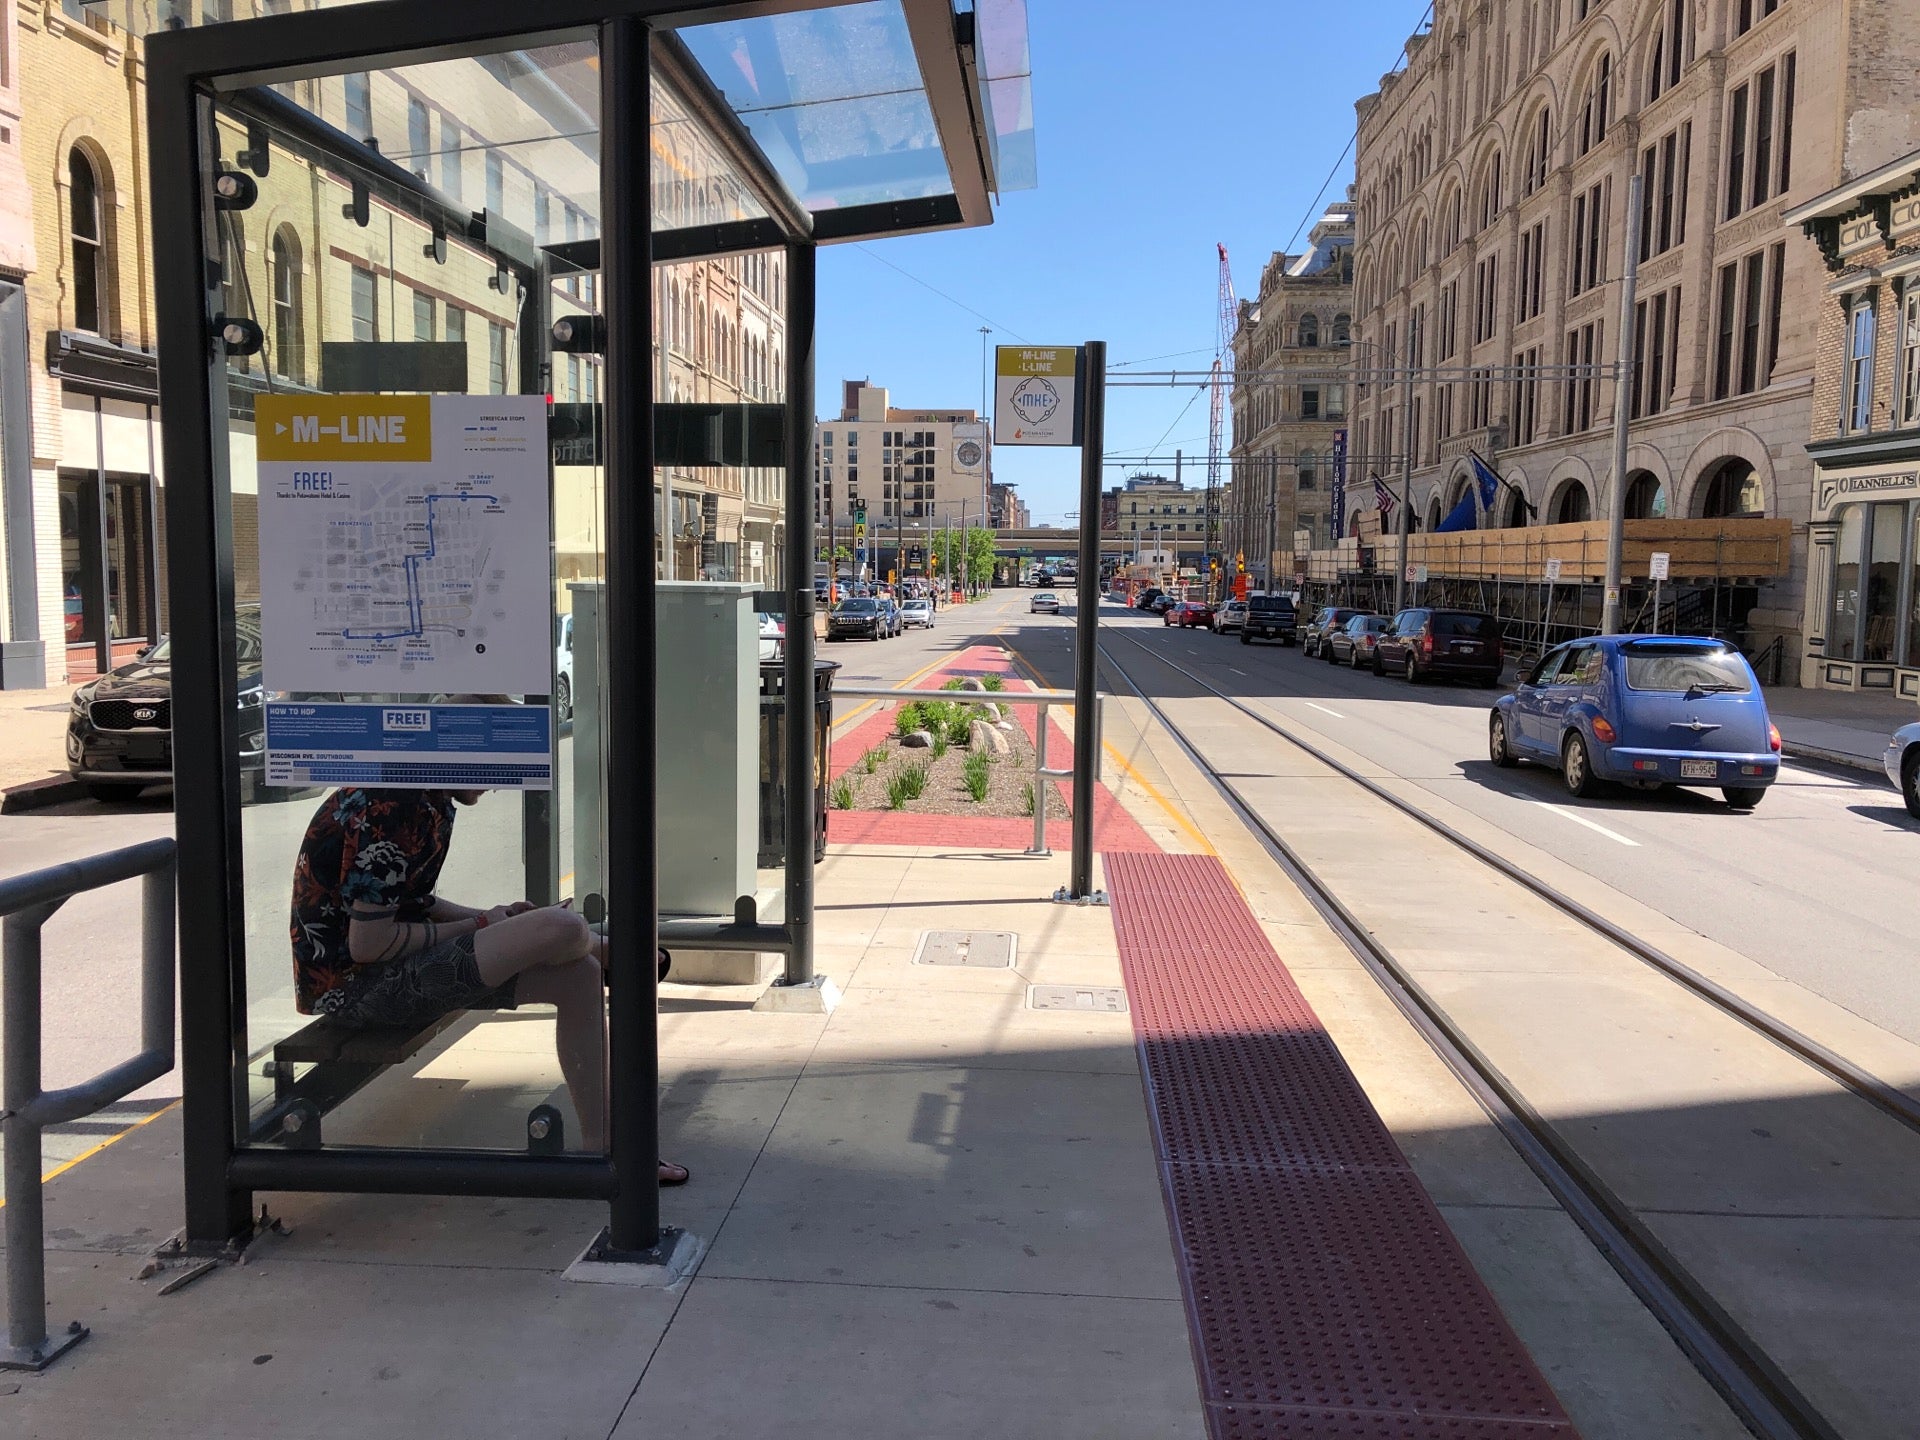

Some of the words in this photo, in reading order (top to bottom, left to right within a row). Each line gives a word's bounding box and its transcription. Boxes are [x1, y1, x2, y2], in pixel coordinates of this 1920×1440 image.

[1022, 350, 1056, 360] M-LINE
[1022, 363, 1053, 372] L-LINE
[1022, 394, 1048, 407] MKE
[292, 416, 406, 442] M-LINE
[294, 472, 332, 490] FREE!
[1854, 475, 1915, 489] IANNELLI'S
[387, 712, 426, 725] FREE!
